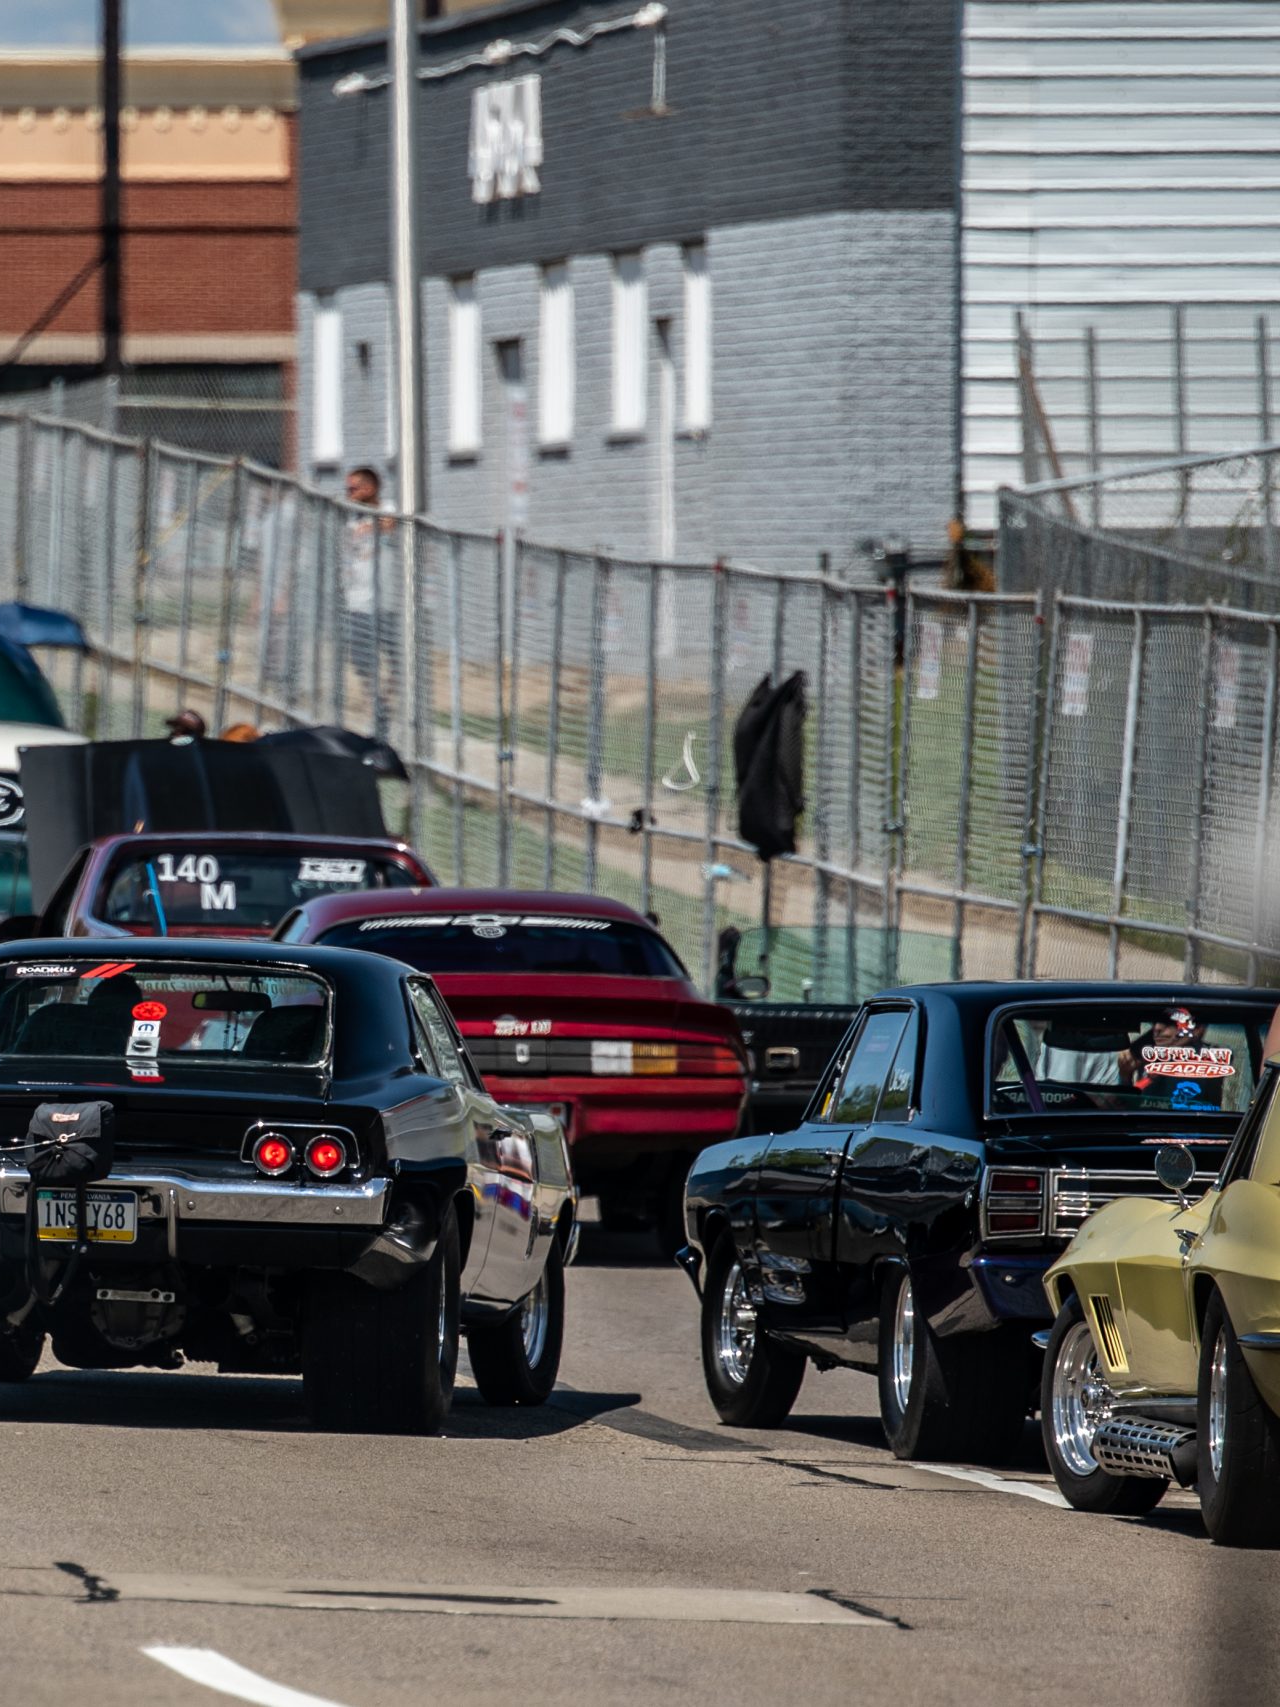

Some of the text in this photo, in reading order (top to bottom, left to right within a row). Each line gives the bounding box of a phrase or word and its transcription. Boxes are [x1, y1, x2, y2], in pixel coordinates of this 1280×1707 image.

[157, 854, 219, 882] 140
[200, 881, 236, 910] M
[16, 966, 76, 974] ROADKILL
[1141, 1046, 1232, 1065] OUTLAW
[1149, 1062, 1230, 1075] HEADERS
[45, 1201, 125, 1229] 1NSY68
